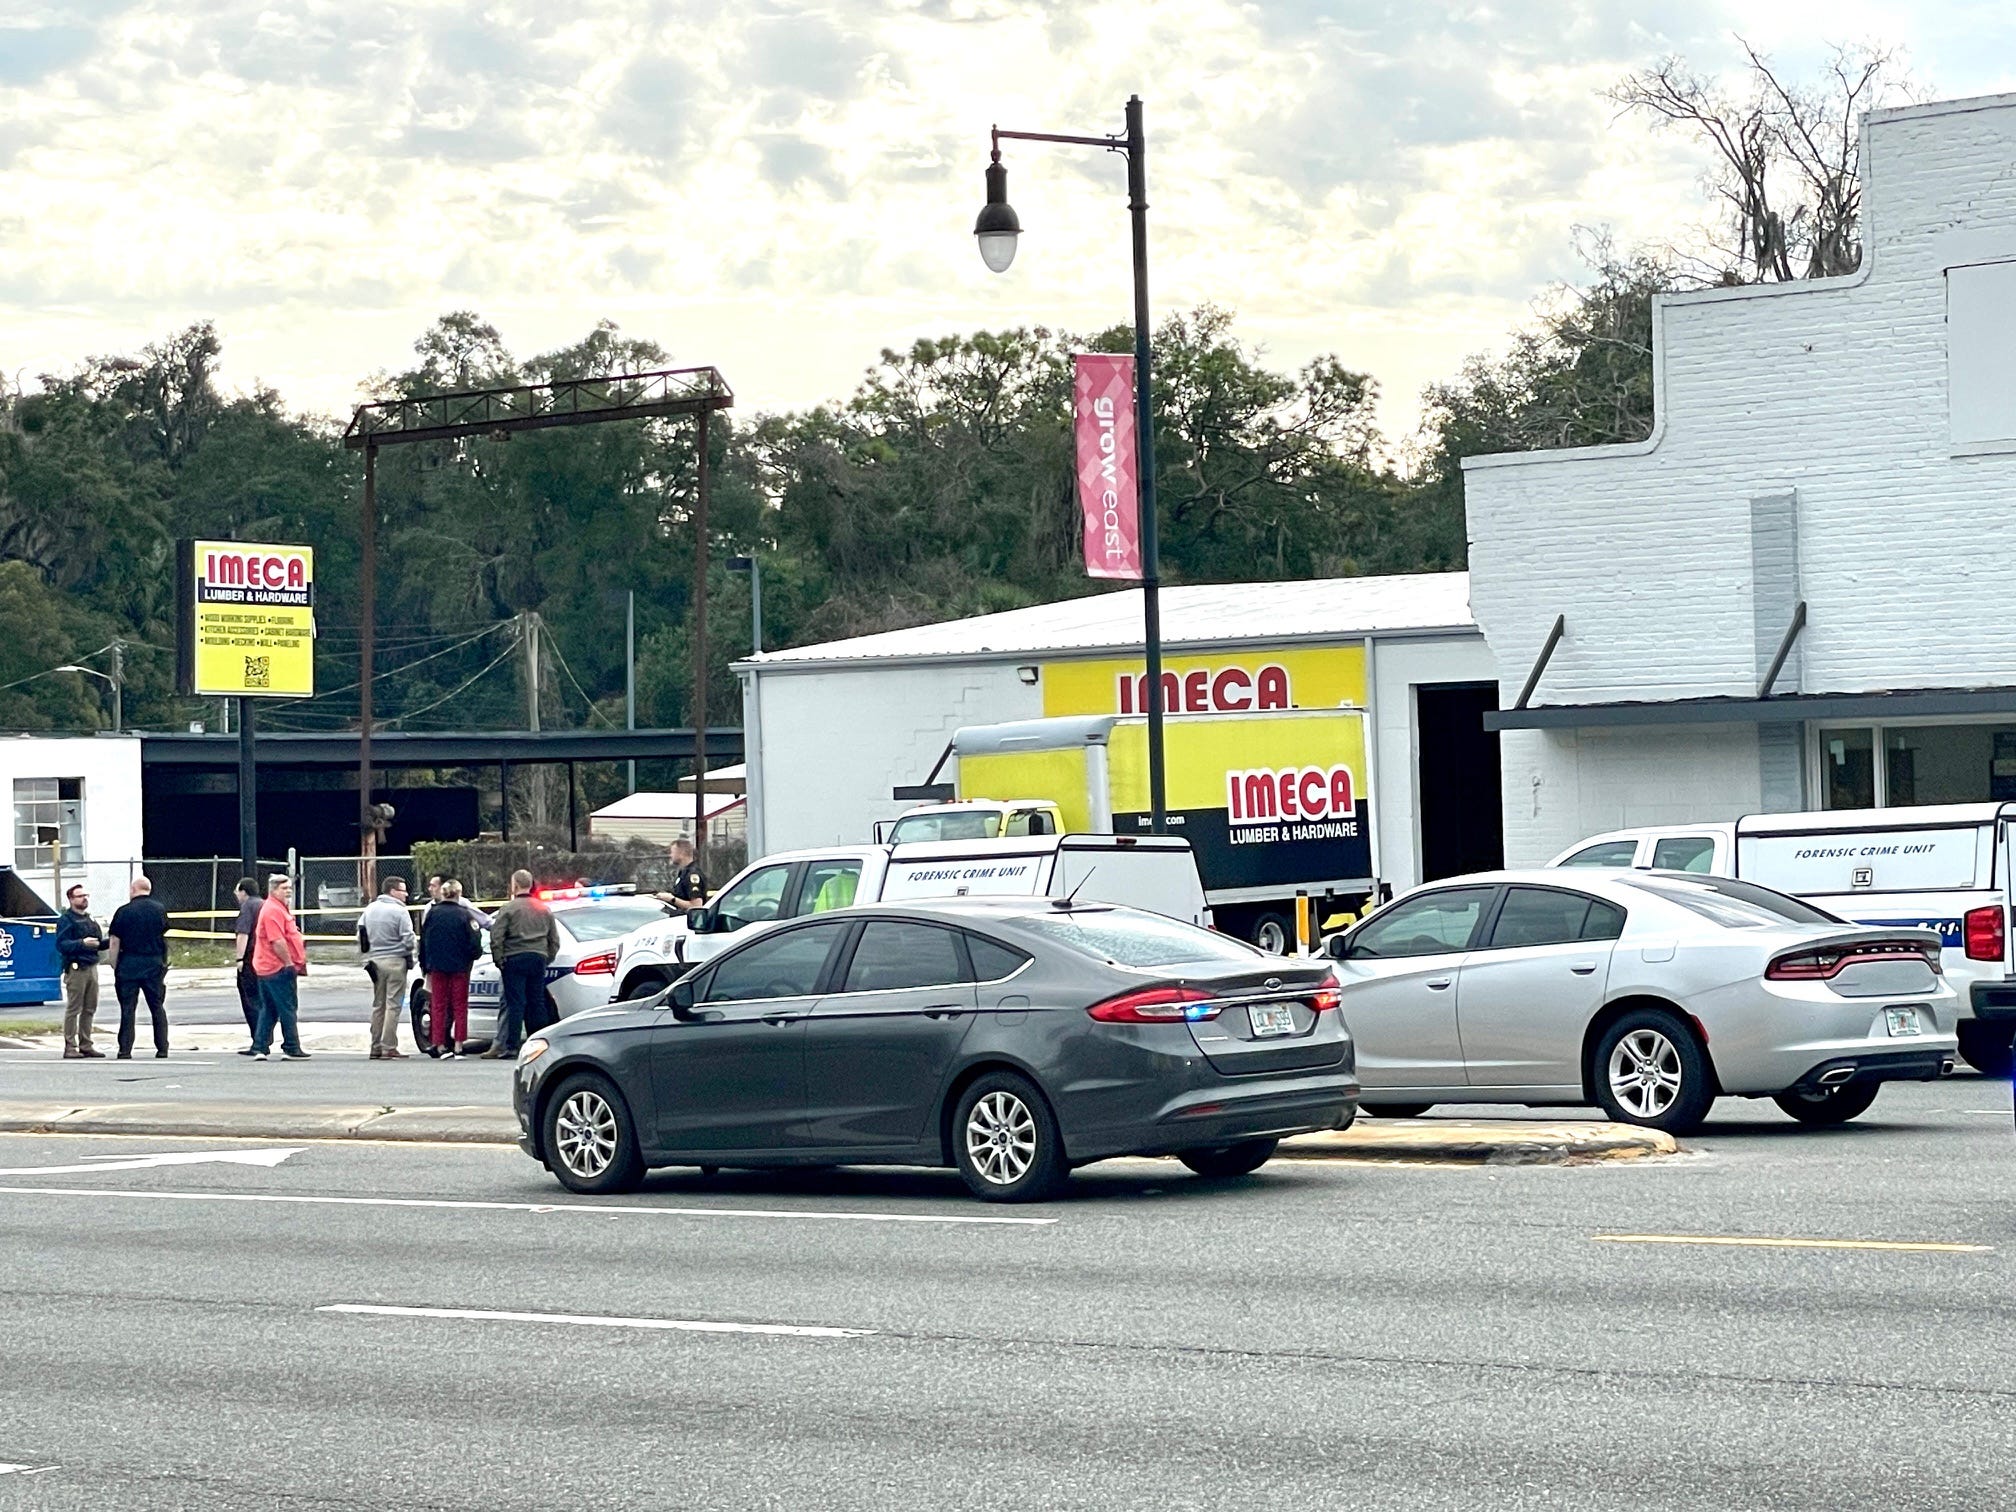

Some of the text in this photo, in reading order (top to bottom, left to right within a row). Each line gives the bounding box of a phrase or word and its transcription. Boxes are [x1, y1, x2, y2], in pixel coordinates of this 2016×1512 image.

[1093, 396, 1124, 560] grow east
[207, 554, 304, 587] IMECA
[204, 589, 308, 604] LUMBER & HARDWARE
[1120, 666, 1288, 714] IMECA
[1230, 769, 1352, 819] IMECA
[1229, 821, 1358, 845] LUMBER & HARDWARE
[1794, 844, 1937, 859] FORENSIC CRIME UNIT
[907, 865, 1028, 882] FORENSIC CRIME UNIT
